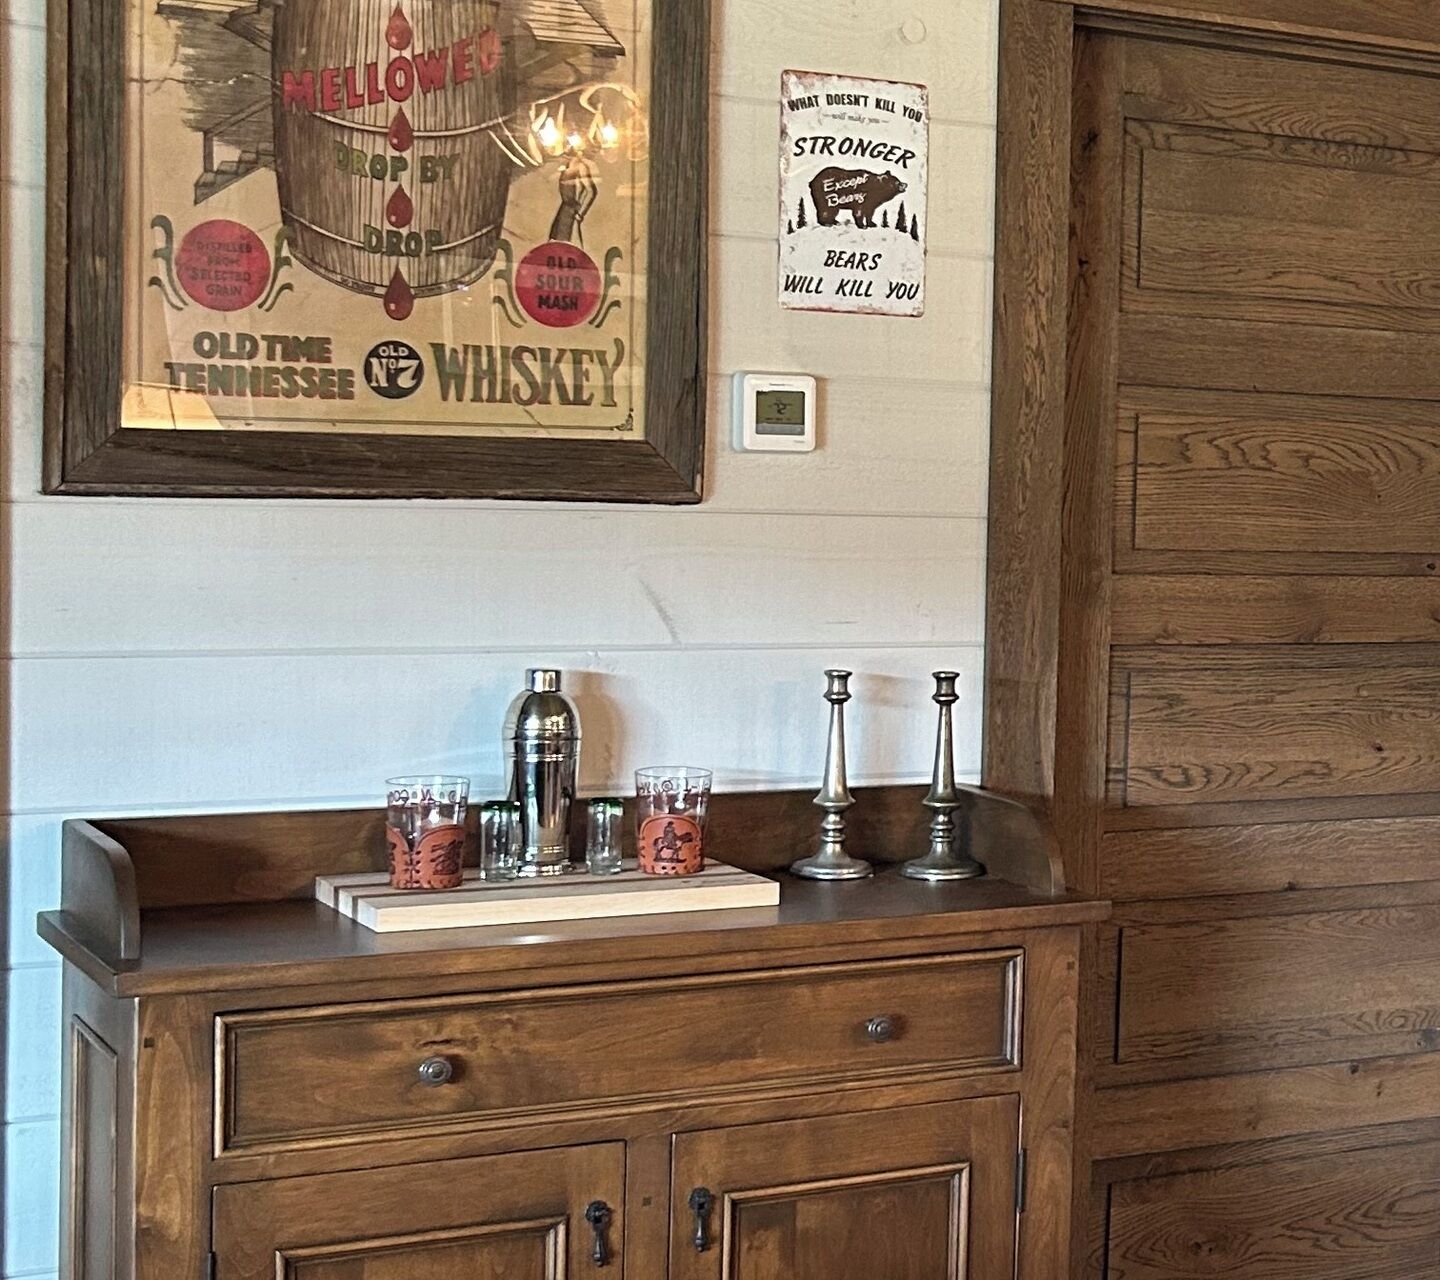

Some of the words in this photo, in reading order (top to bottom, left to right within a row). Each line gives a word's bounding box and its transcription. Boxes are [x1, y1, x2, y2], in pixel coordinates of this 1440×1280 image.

[281, 24, 501, 113] MELLOWED
[787, 94, 820, 112] WHAT
[826, 93, 870, 108] DOESN'T
[875, 97, 896, 114] KILL
[902, 104, 923, 123] YOU
[334, 140, 409, 182] DROP
[419, 153, 461, 184] BY
[793, 135, 916, 169] STRONGER
[823, 173, 869, 192] Except
[827, 192, 867, 207] Bears
[363, 223, 444, 258] DROP
[546, 256, 577, 270] OLD
[824, 250, 883, 271] BEARS
[205, 283, 242, 297] GRAIN
[535, 273, 584, 291] SOUR
[784, 274, 824, 294] WILL
[835, 278, 874, 298] KILL
[885, 281, 920, 301] YOU
[537, 294, 578, 311] MASH
[193, 331, 259, 360] OLD
[261, 334, 332, 364] TIME
[379, 345, 409, 358] OLD
[164, 361, 355, 401] TENNESSEE
[428, 337, 625, 408] WHISKEY
